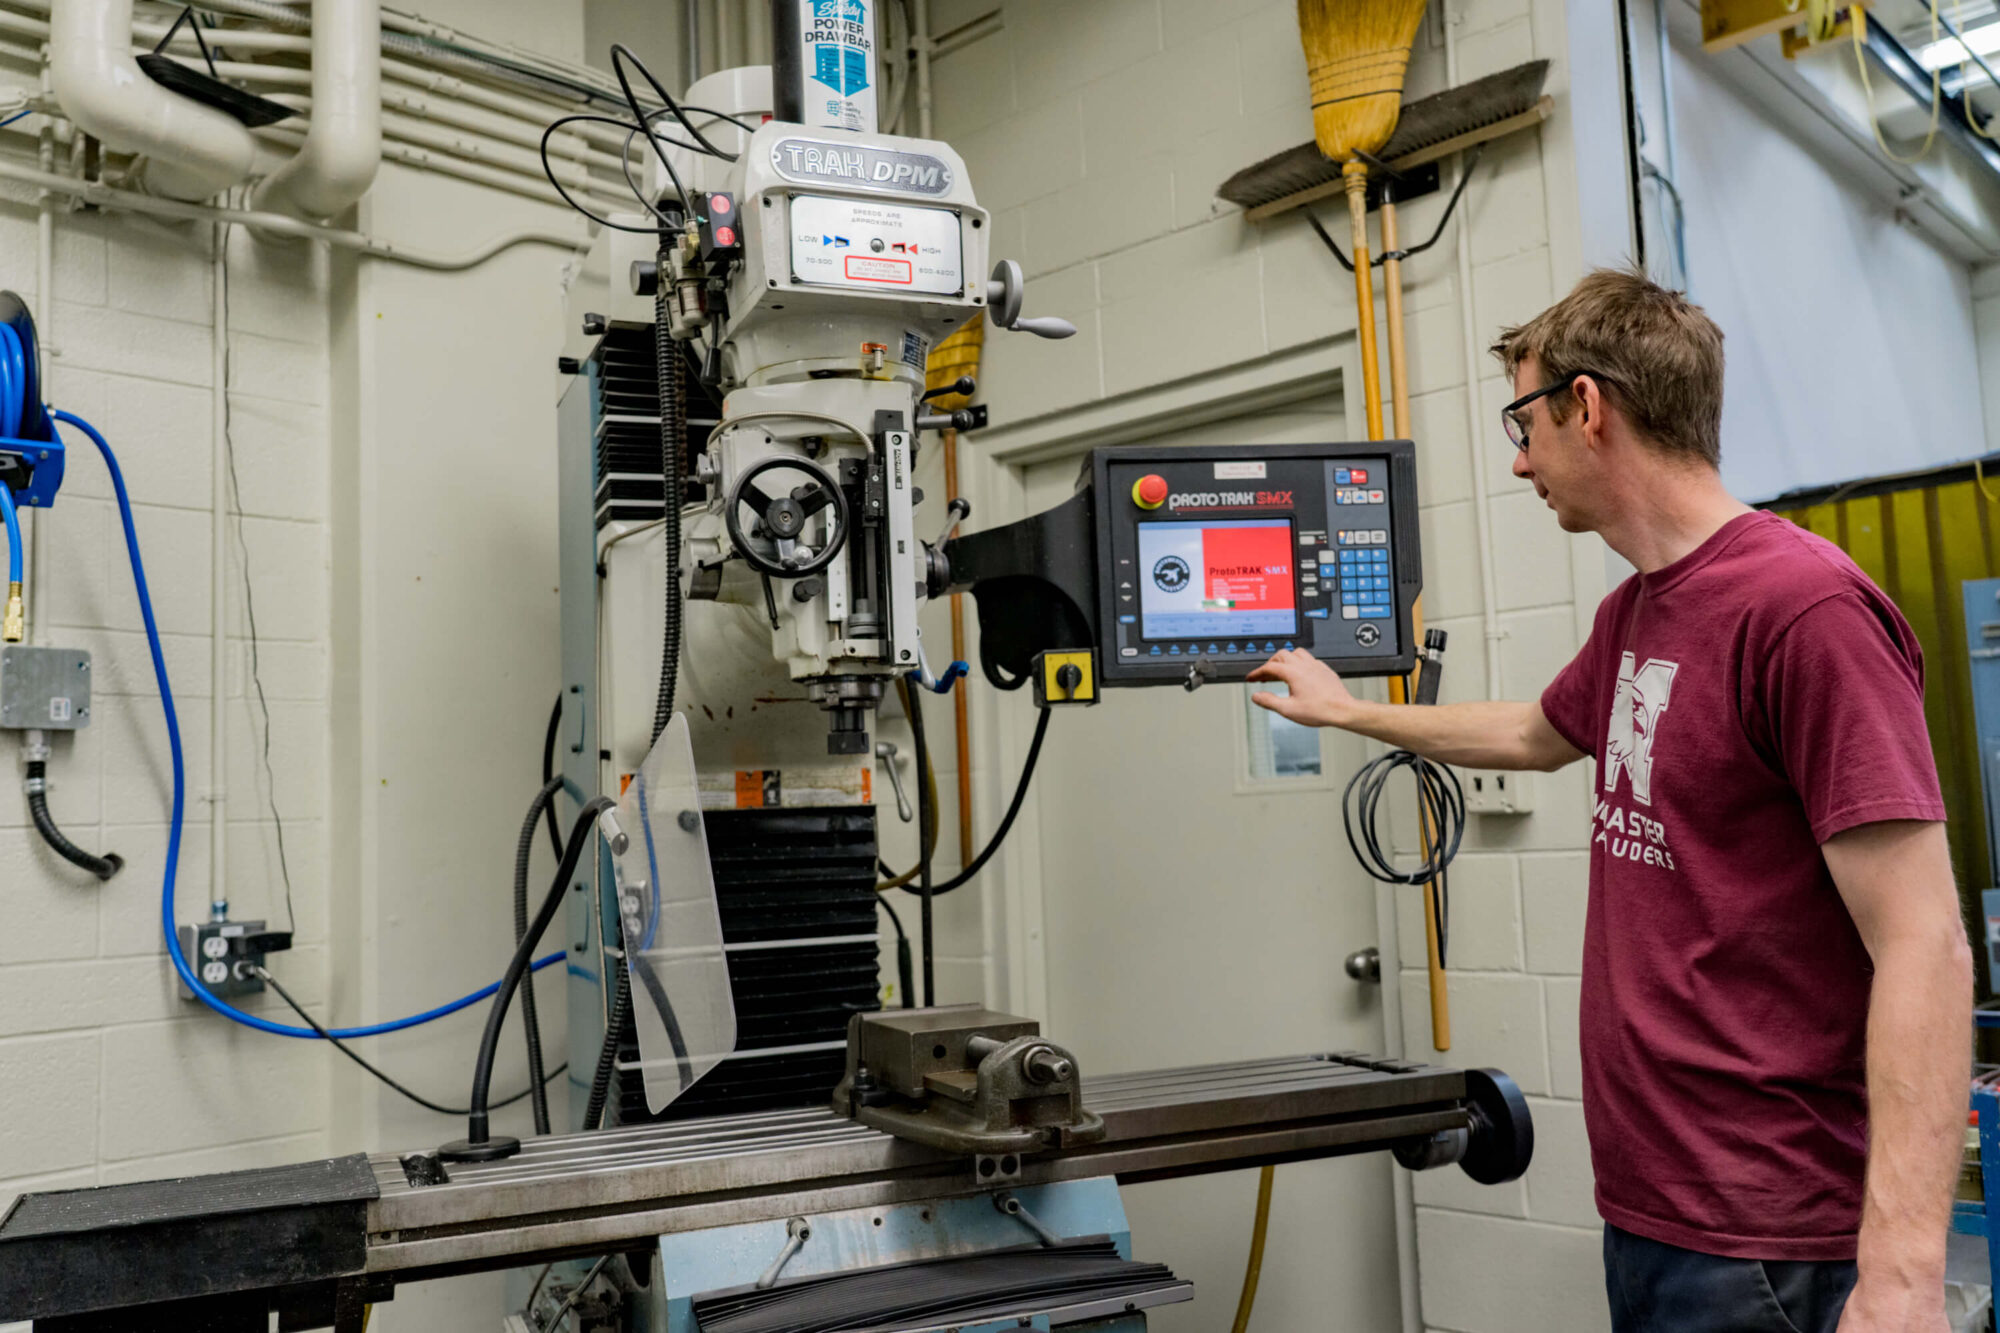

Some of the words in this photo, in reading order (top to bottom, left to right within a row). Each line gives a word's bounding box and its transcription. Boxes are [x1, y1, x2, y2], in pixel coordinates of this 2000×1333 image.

[814, 19, 864, 36] POWER
[804, 31, 872, 52] DRAWBAR
[785, 144, 865, 179] TRAK
[872, 161, 938, 187] DPM
[853, 208, 882, 217] SPEEDS
[851, 217, 902, 228] APPROXIMATE
[798, 235, 818, 243] LOW
[921, 247, 941, 255] HIGH
[861, 261, 896, 269] CAUTION
[1168, 492, 1219, 511] PROTO
[1219, 491, 1255, 505] TRAK
[1255, 490, 1293, 505] SMX
[1209, 565, 1262, 576] ProtoTRAK
[1263, 565, 1288, 575] SMX
